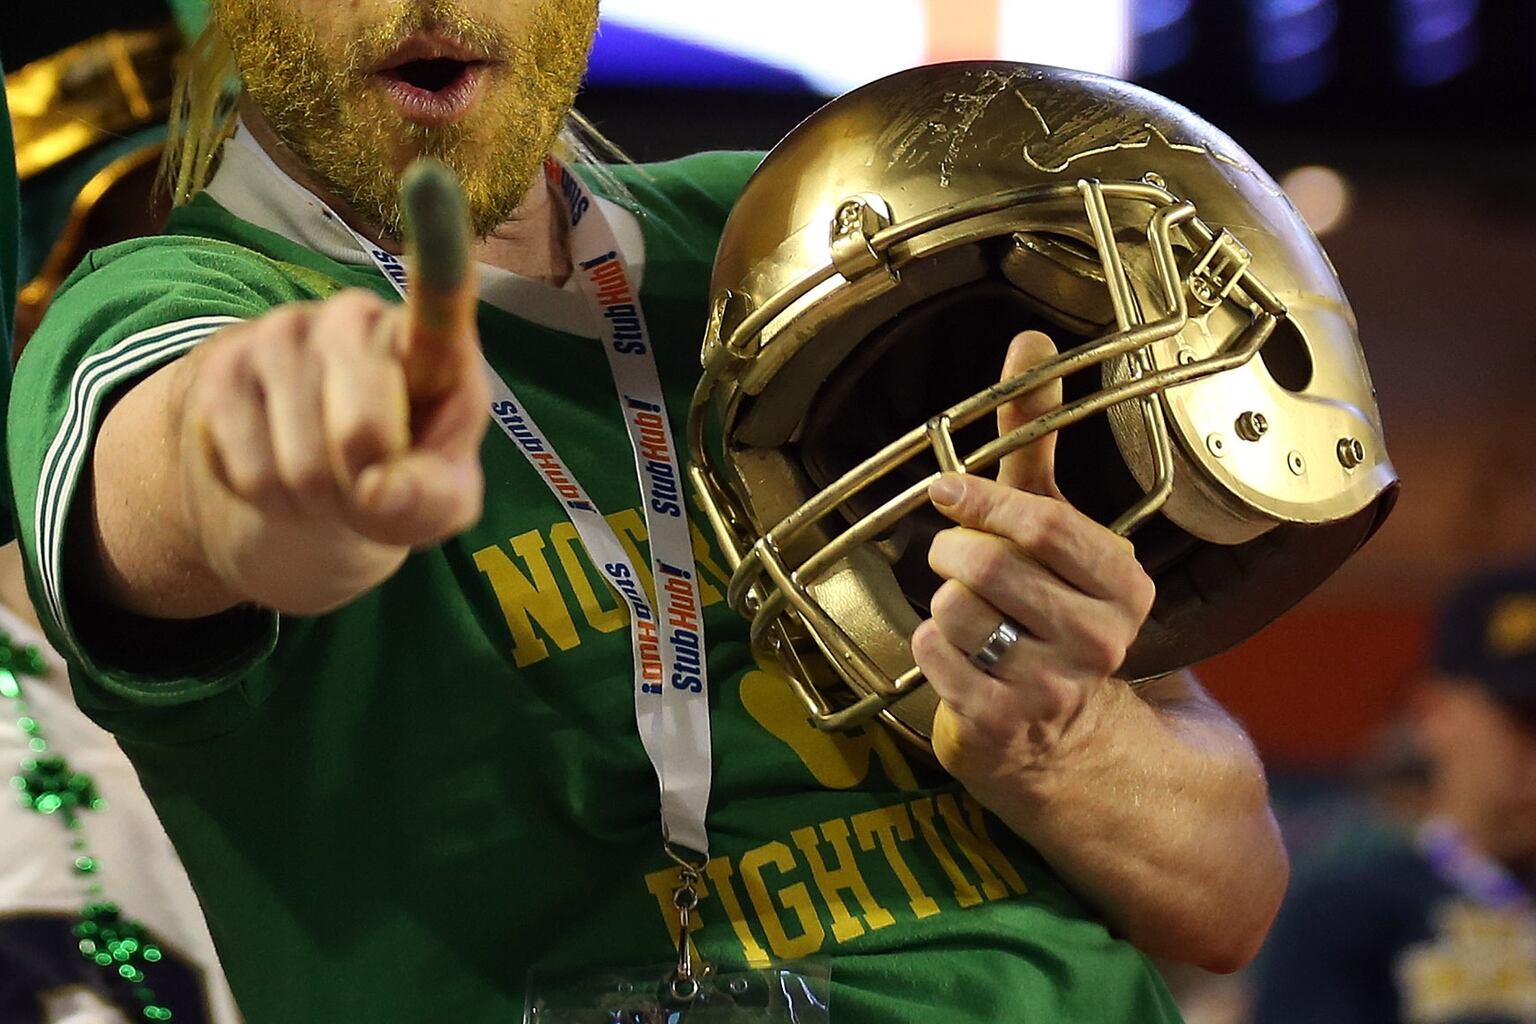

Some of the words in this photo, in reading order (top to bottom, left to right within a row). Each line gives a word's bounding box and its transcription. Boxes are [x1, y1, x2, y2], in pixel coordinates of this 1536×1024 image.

[578, 250, 646, 356] StubHub!
[490, 400, 598, 514] StubHub!
[624, 394, 681, 518] StubHub!
[656, 558, 702, 694] StubHub!
